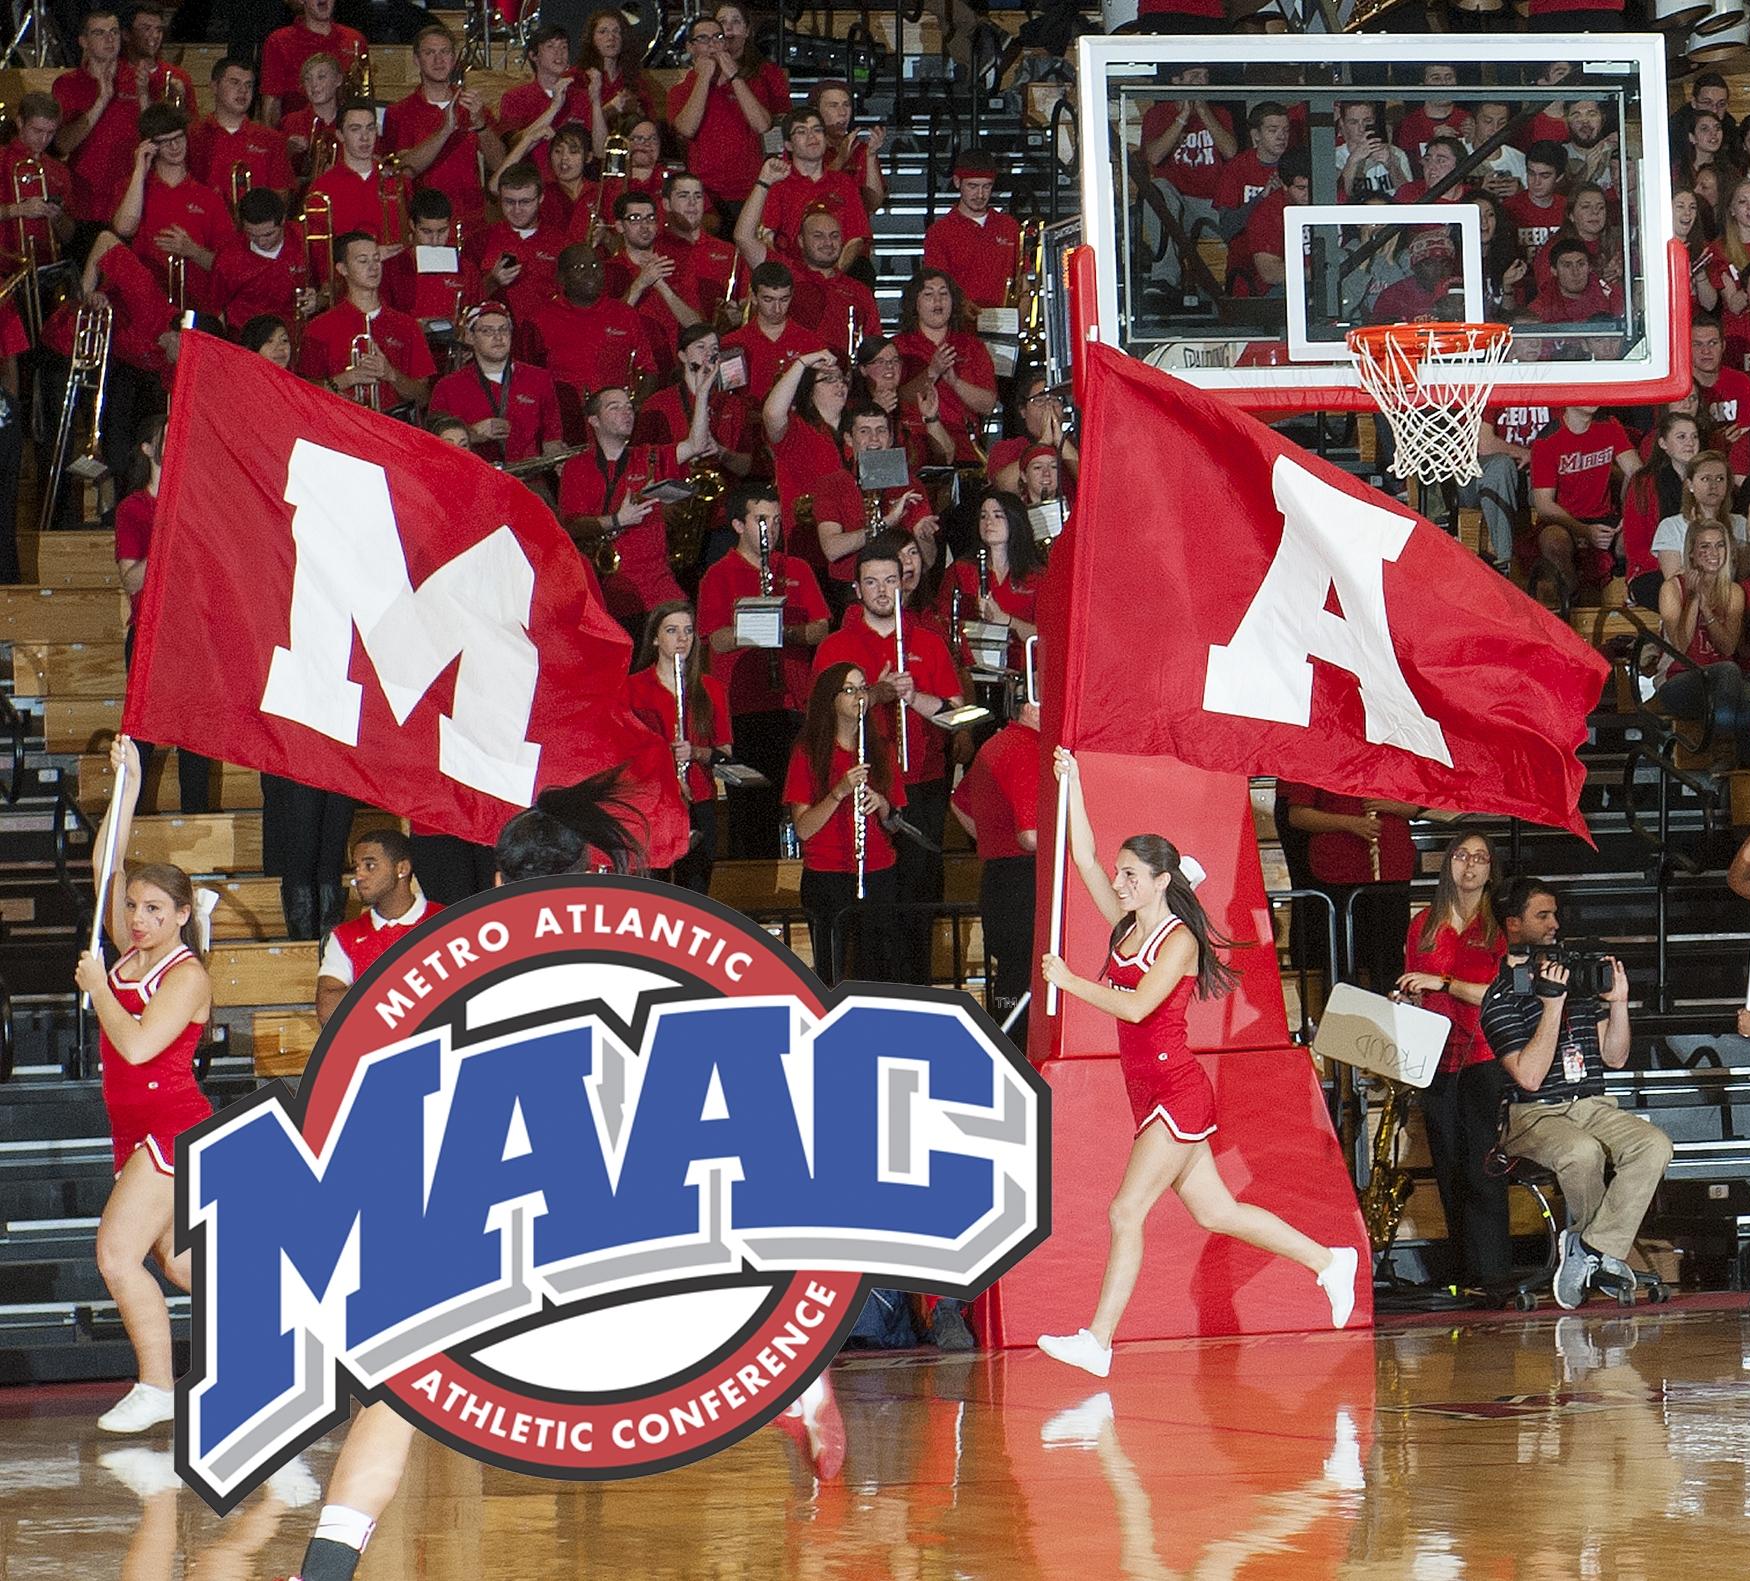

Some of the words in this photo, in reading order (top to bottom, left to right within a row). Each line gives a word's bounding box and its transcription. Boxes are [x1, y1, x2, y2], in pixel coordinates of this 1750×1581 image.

[1518, 227, 1549, 248] FEED
[260, 437, 541, 808] M
[1202, 454, 1454, 769] A
[1355, 1034, 1428, 1080] PROUD
